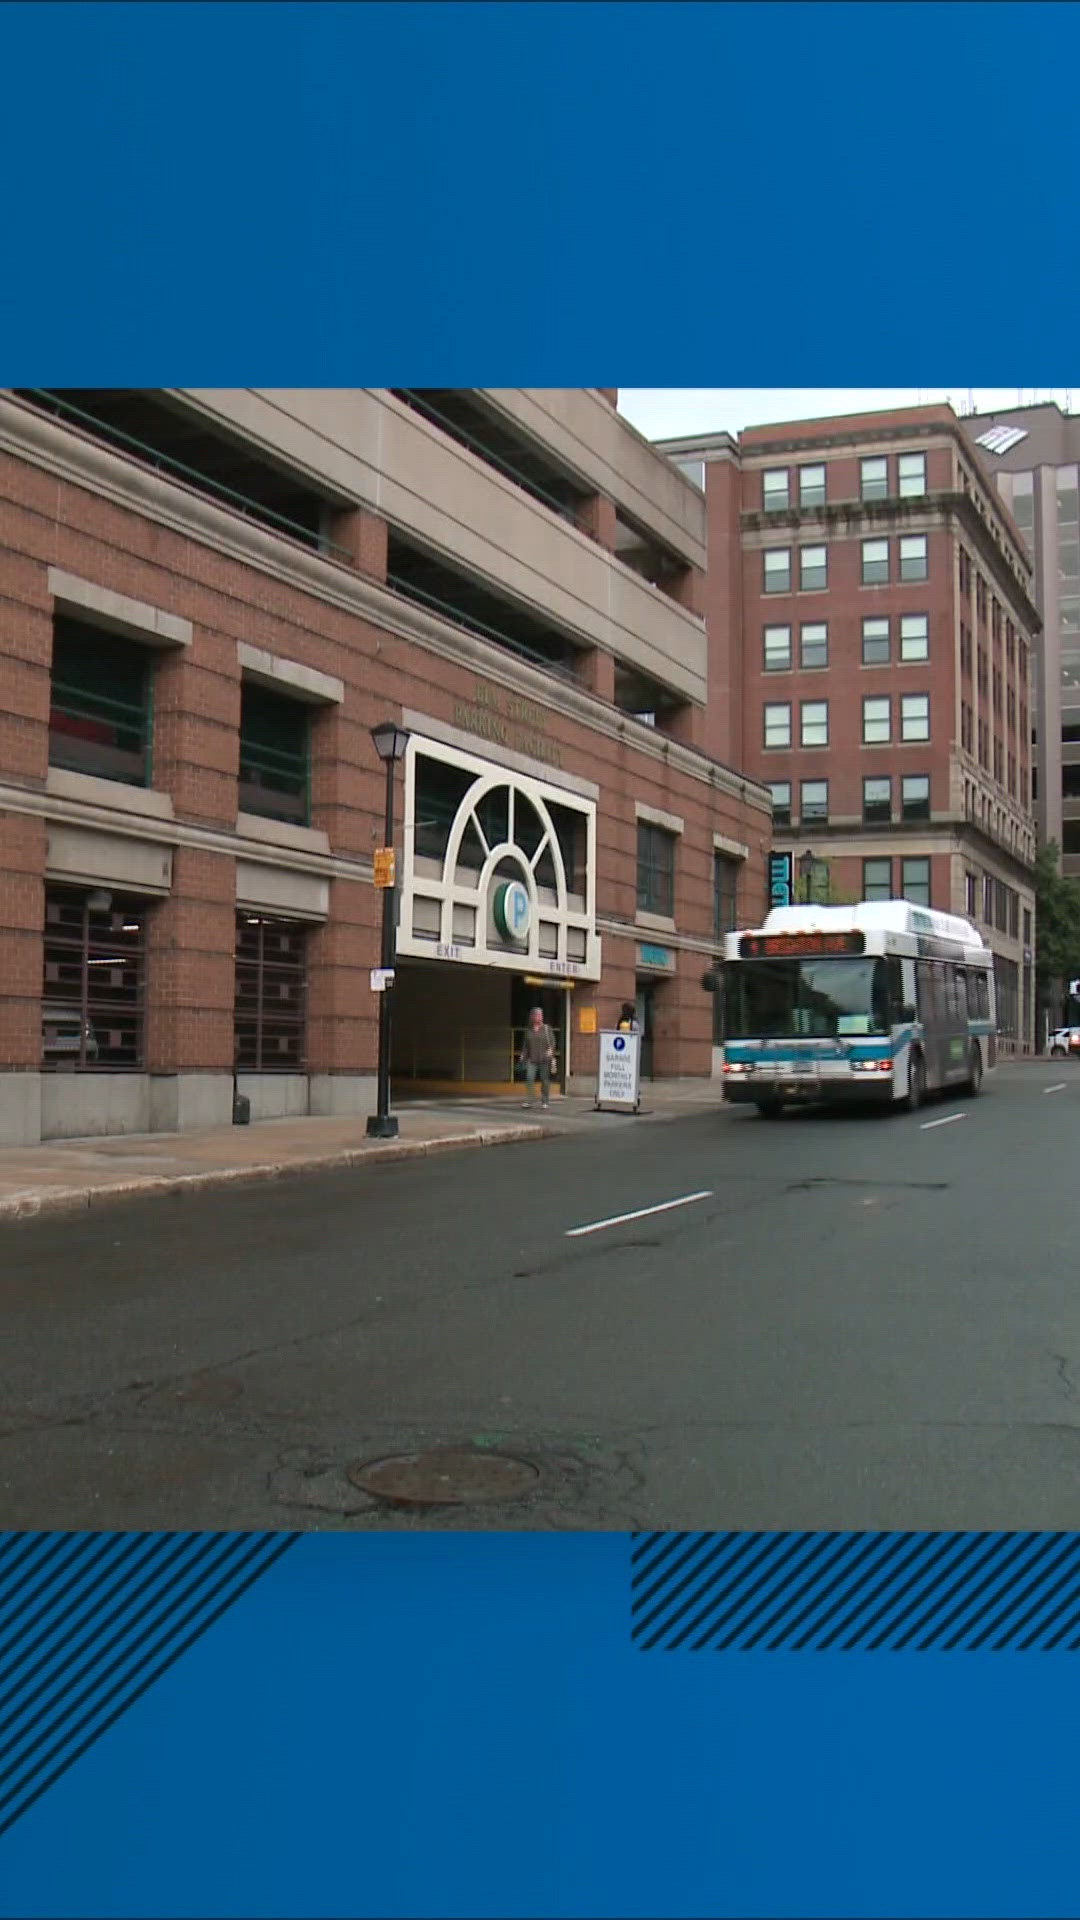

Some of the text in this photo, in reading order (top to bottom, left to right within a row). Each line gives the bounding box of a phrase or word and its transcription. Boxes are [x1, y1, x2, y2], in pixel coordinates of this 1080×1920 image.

[508, 699, 545, 728] STREET
[455, 703, 508, 743] PARKING
[514, 891, 526, 928] P
[436, 944, 460, 958] EXIT
[550, 962, 578, 974] ENTER
[606, 1054, 631, 1063] GARAGE
[610, 1063, 625, 1071] FULL
